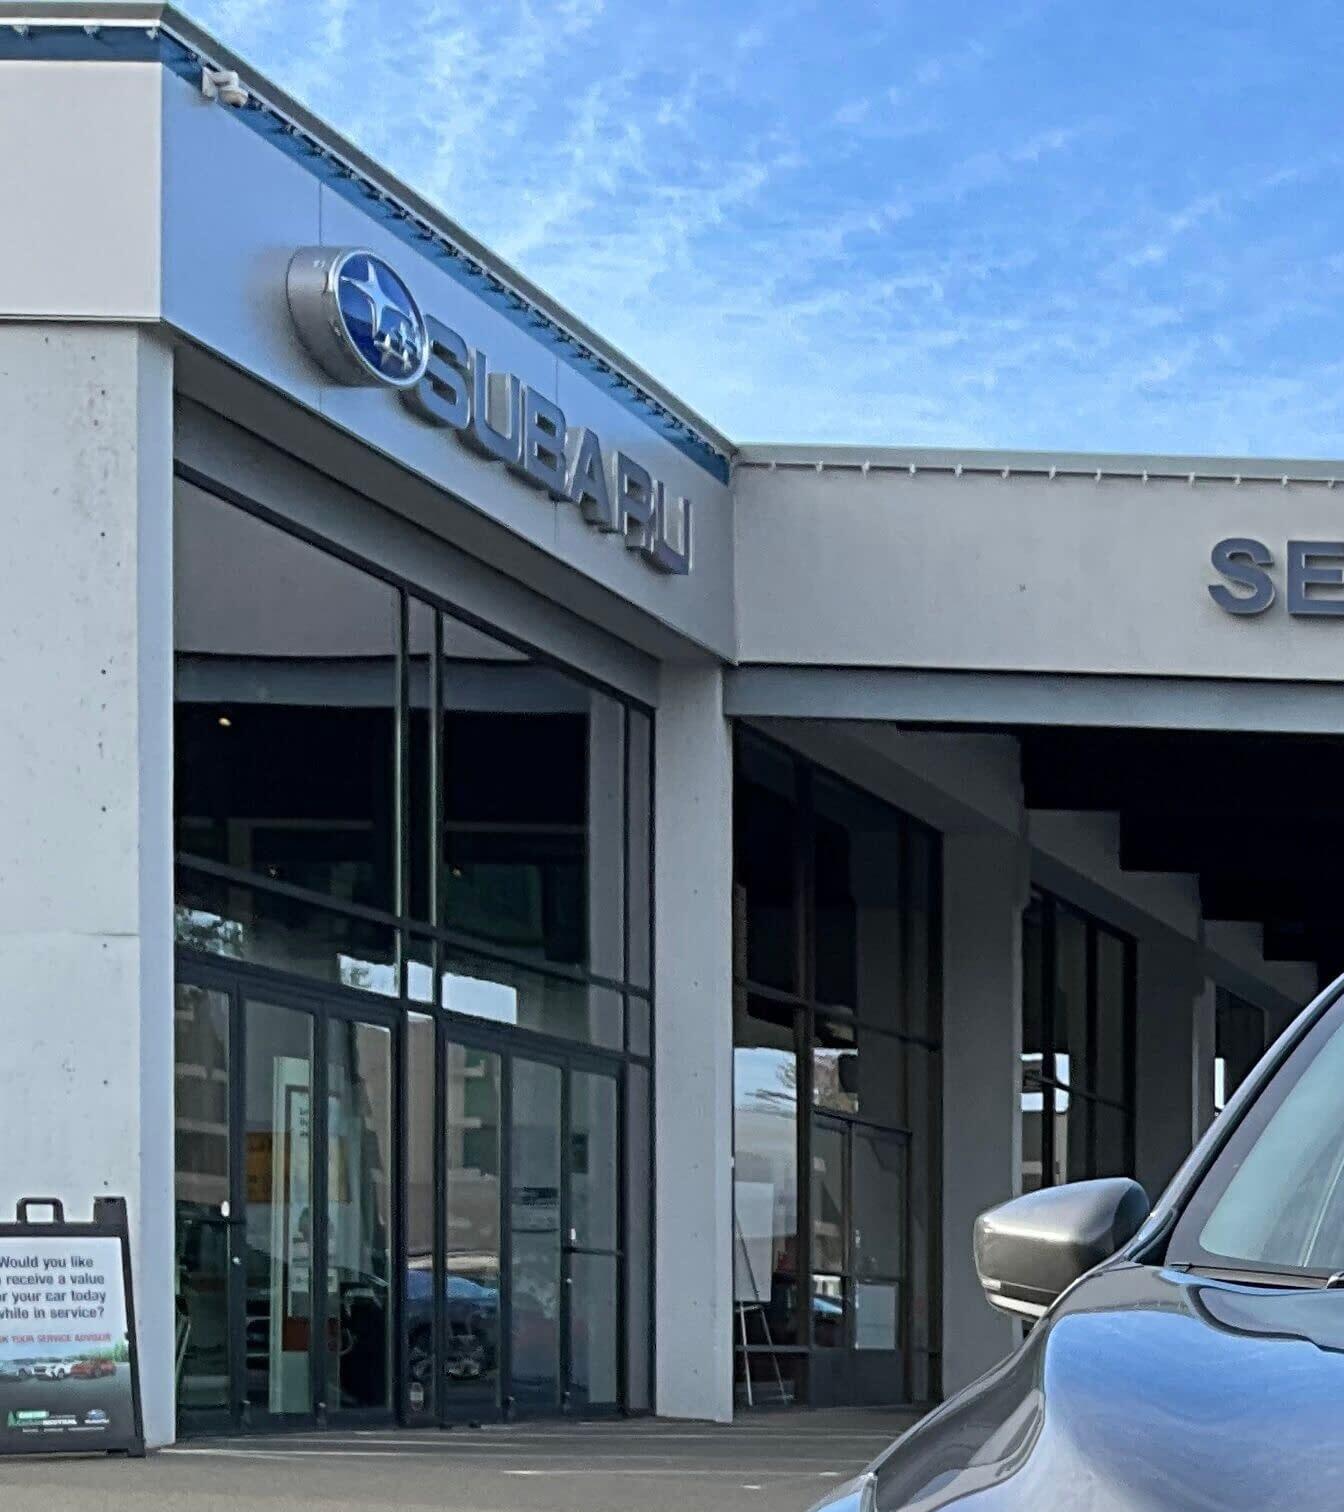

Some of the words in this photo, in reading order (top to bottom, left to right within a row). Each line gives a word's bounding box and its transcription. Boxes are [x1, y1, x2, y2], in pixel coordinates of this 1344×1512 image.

[412, 313, 693, 576] SUBARU
[0, 1256, 38, 1268] Would
[43, 1257, 66, 1270] you
[71, 1256, 93, 1268] like
[6, 1273, 53, 1285] receive
[58, 1275, 65, 1284] a
[70, 1273, 104, 1285] value
[12, 1291, 40, 1304] your
[45, 1291, 66, 1301] car
[71, 1290, 106, 1304] today
[34, 1307, 45, 1318] in
[50, 1306, 104, 1319] service?
